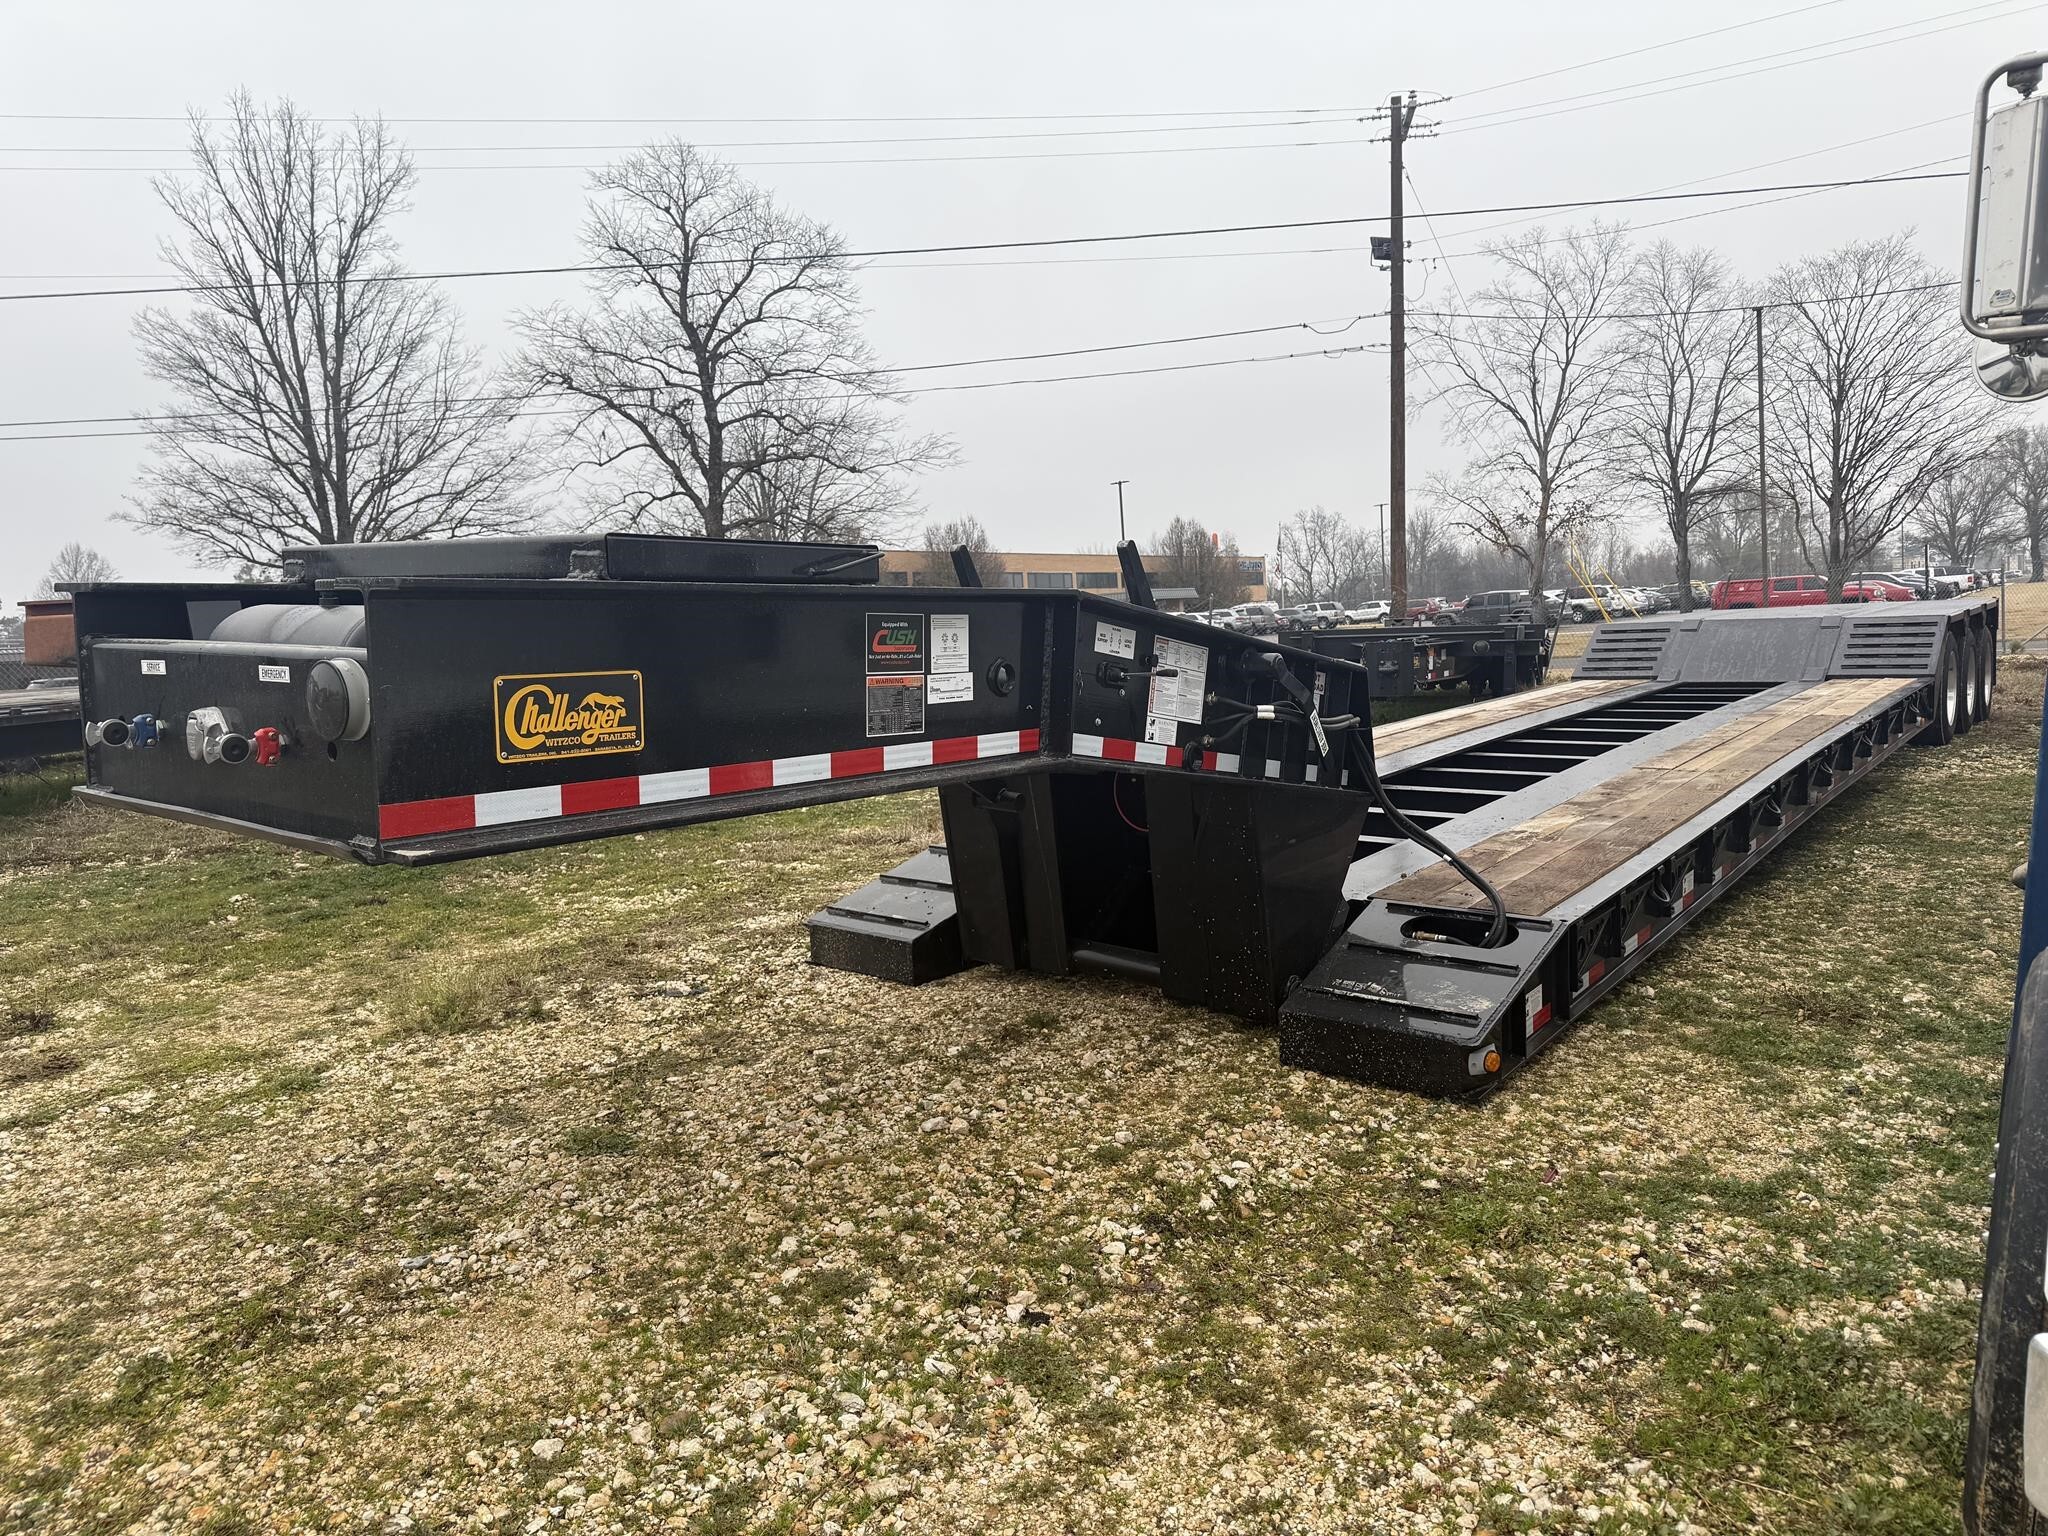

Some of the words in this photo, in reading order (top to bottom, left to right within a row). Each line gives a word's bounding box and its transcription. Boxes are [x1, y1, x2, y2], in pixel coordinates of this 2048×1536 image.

[873, 630, 917, 652] CUSH
[146, 663, 161, 672] SERVICE
[261, 668, 287, 679] EMERGENCY
[505, 684, 636, 750] Challenger
[545, 737, 581, 747] WITZCO
[599, 732, 637, 742] TRAILERS
